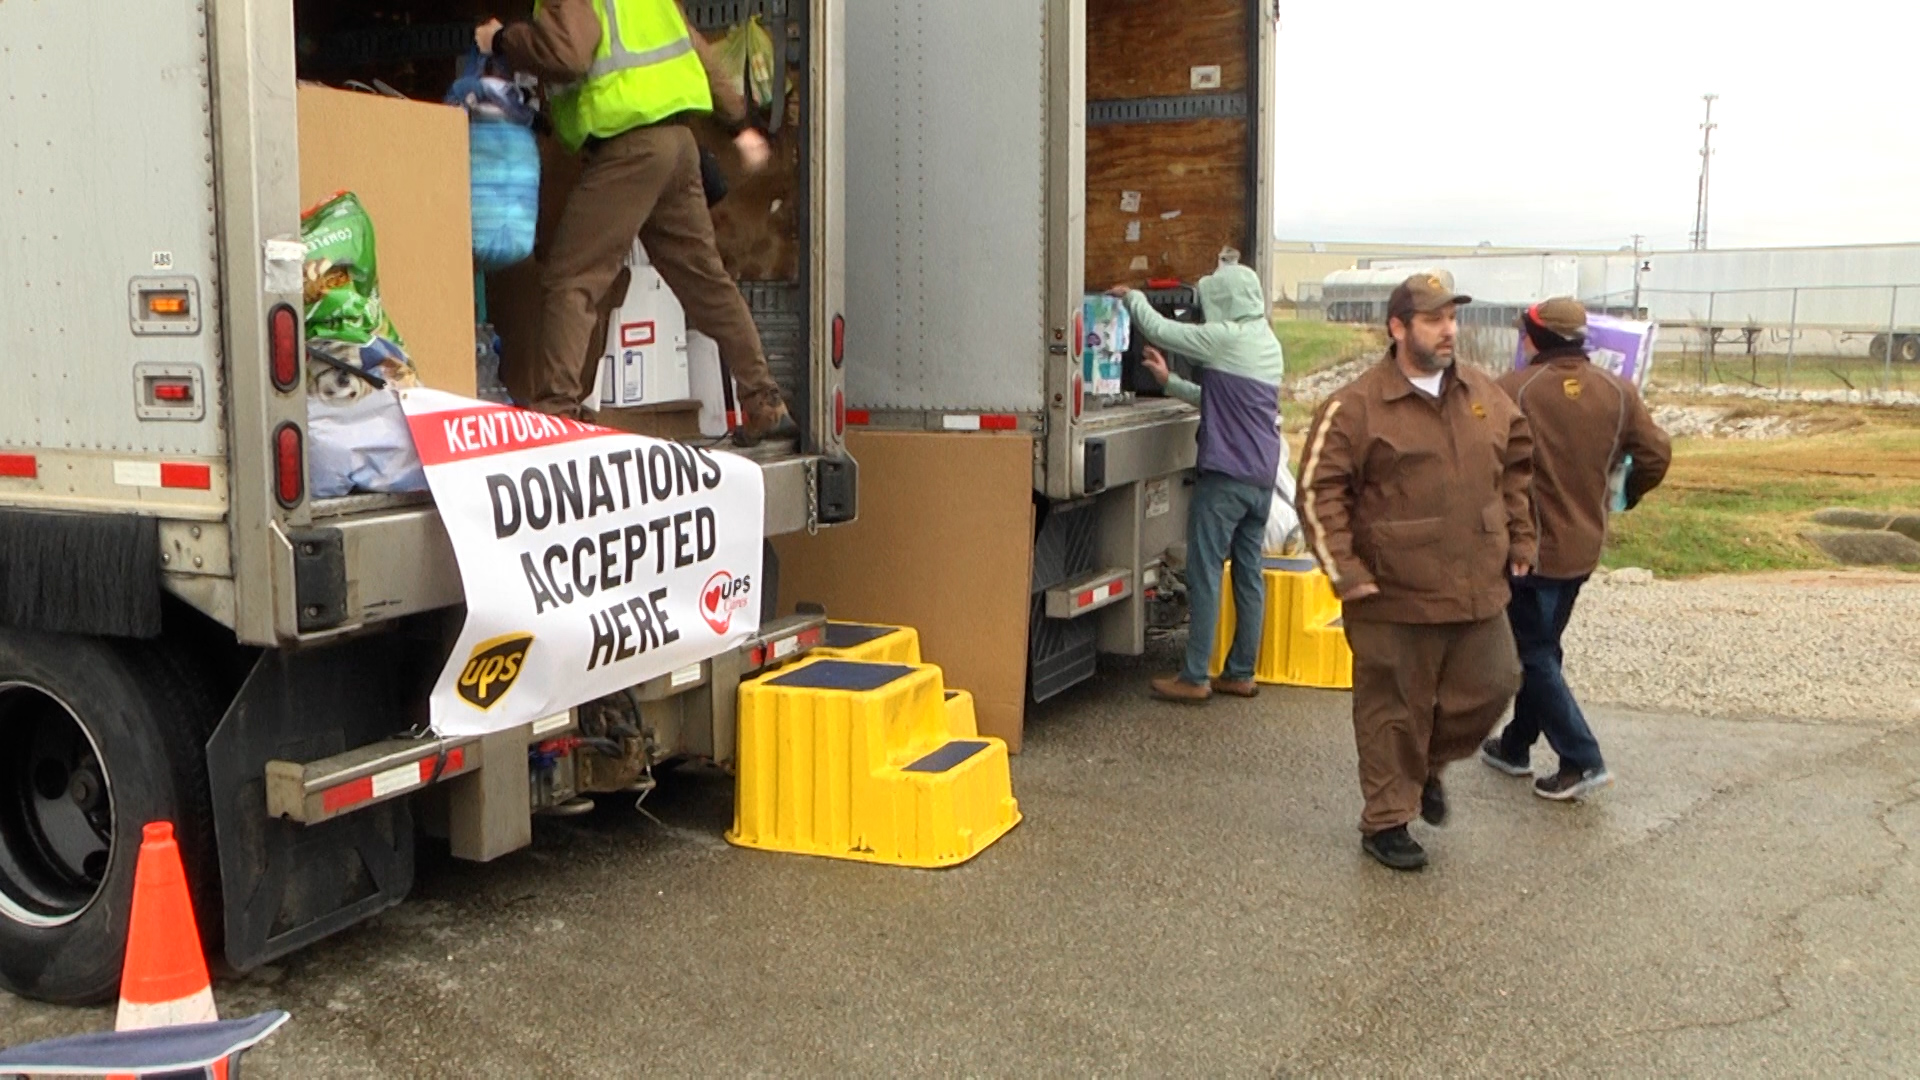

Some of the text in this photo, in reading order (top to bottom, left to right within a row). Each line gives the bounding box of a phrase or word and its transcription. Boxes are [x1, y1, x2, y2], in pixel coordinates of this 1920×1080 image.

[443, 411, 568, 453] KENTUCKY
[486, 444, 722, 539] DONATIONS
[520, 507, 716, 615] ACCEPTED
[721, 574, 751, 600] UPS
[586, 587, 679, 670] HERE
[461, 652, 523, 699] ups
